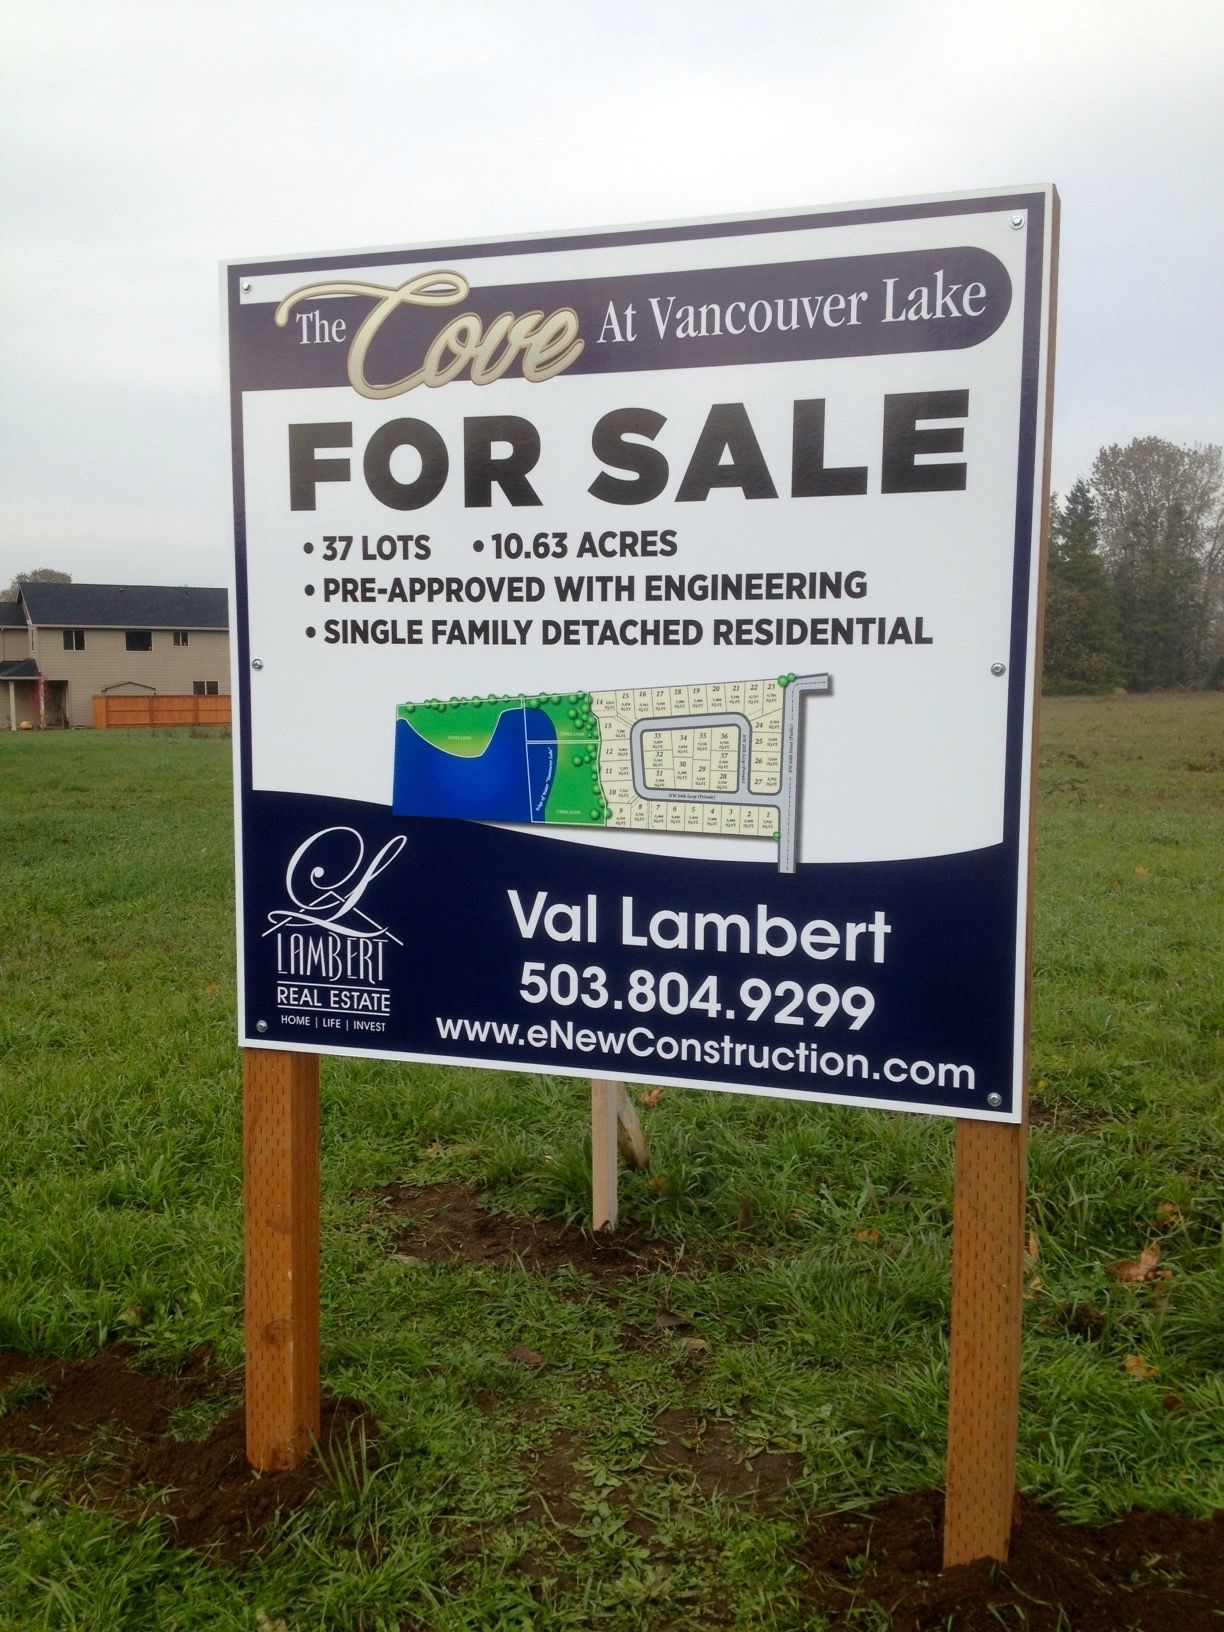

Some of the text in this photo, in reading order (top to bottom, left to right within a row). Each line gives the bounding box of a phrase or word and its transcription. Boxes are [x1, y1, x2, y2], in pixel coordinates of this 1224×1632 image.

[273, 269, 987, 400] The Cove At Vancouver Lake
[288, 389, 970, 511] FOR SALE
[322, 534, 431, 561] 37 LOTS
[491, 529, 678, 560] 10.63 ACRES
[323, 570, 868, 603] PRE-APPROVED WITH ENGINEERING
[323, 616, 934, 646] SINGLE FAMILY DETACHED RESIDENTIAL
[507, 889, 892, 964] Val Lambert
[277, 932, 389, 984] LAMBERT
[277, 986, 391, 1013] REAL ESTATE
[519, 961, 876, 1031] 503.804.9299
[281, 1014, 386, 1032] HOME LIFE INVEST
[435, 1017, 976, 1090] www.eNewConstruction.com
